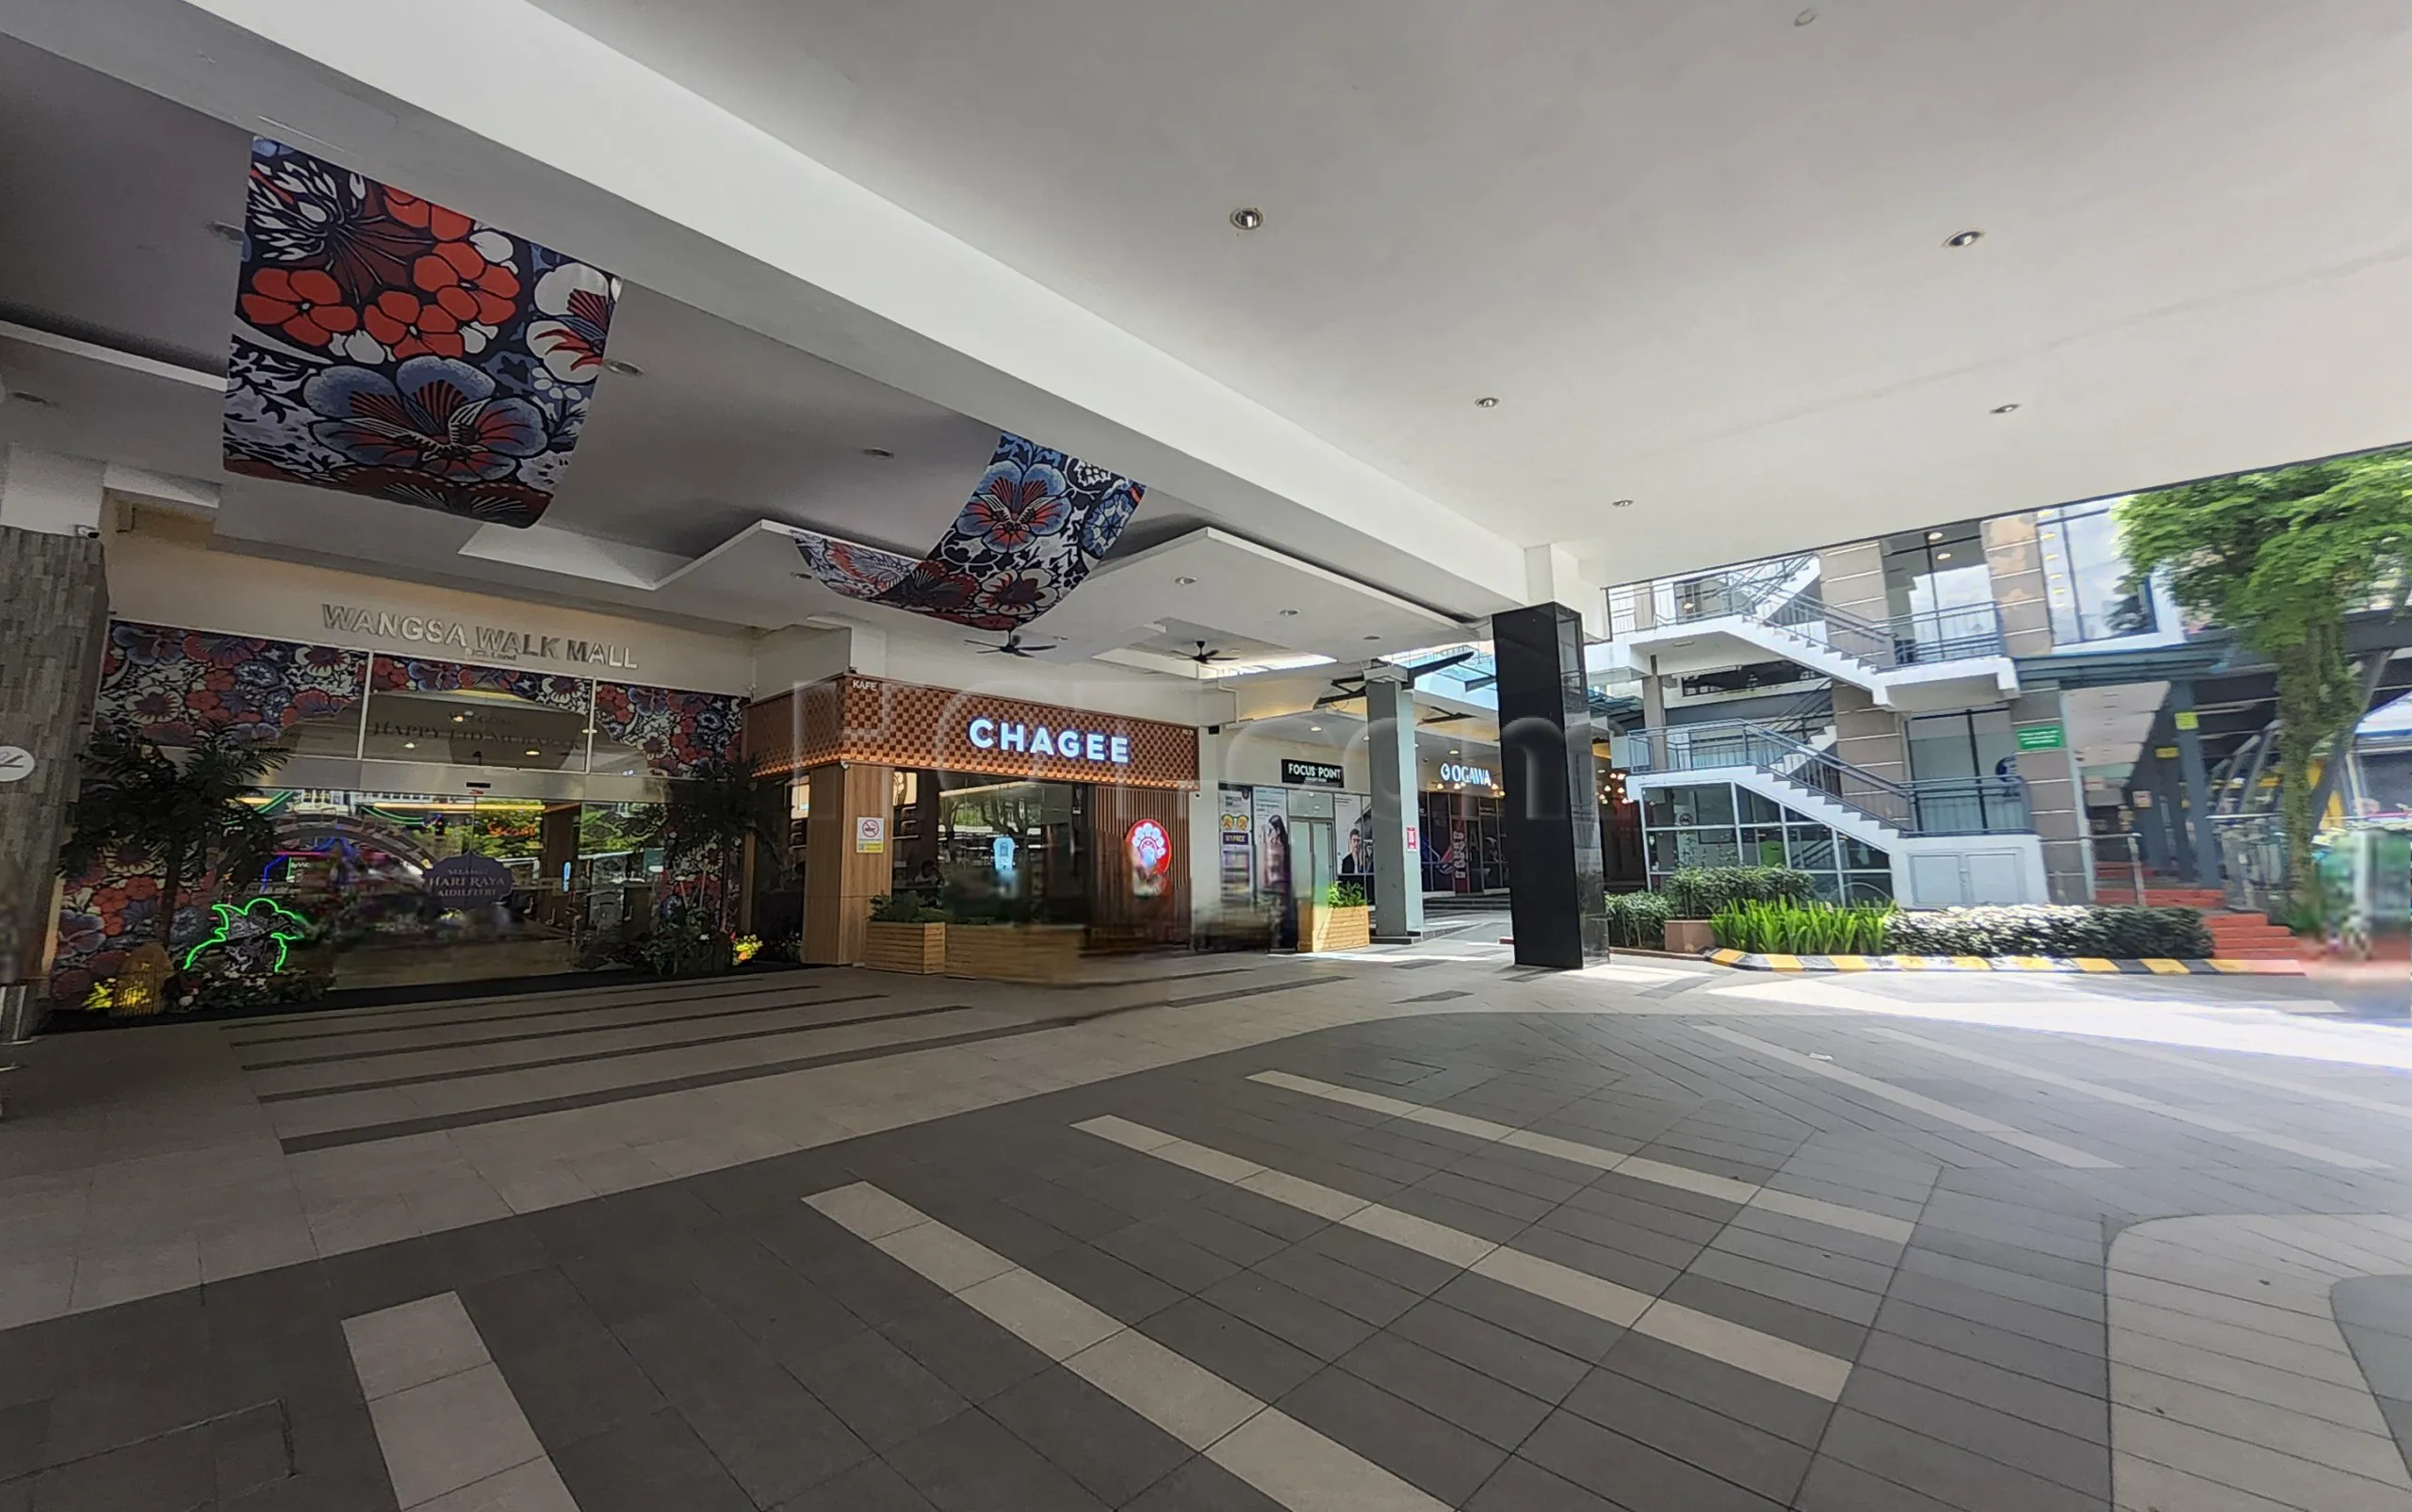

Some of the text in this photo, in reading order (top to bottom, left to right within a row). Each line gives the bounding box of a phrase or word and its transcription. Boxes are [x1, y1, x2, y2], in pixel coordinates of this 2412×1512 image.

[321, 604, 638, 669] WANGSA WALK MALL
[853, 679, 878, 691] KAFE
[373, 722, 440, 738] HAPPY
[969, 717, 1132, 764] CHAGEE
[1288, 763, 1315, 777] FOCUS
[1318, 766, 1342, 780] POINT
[1452, 764, 1492, 787] OGAWA
[429, 875, 505, 887] HARI RAYA
